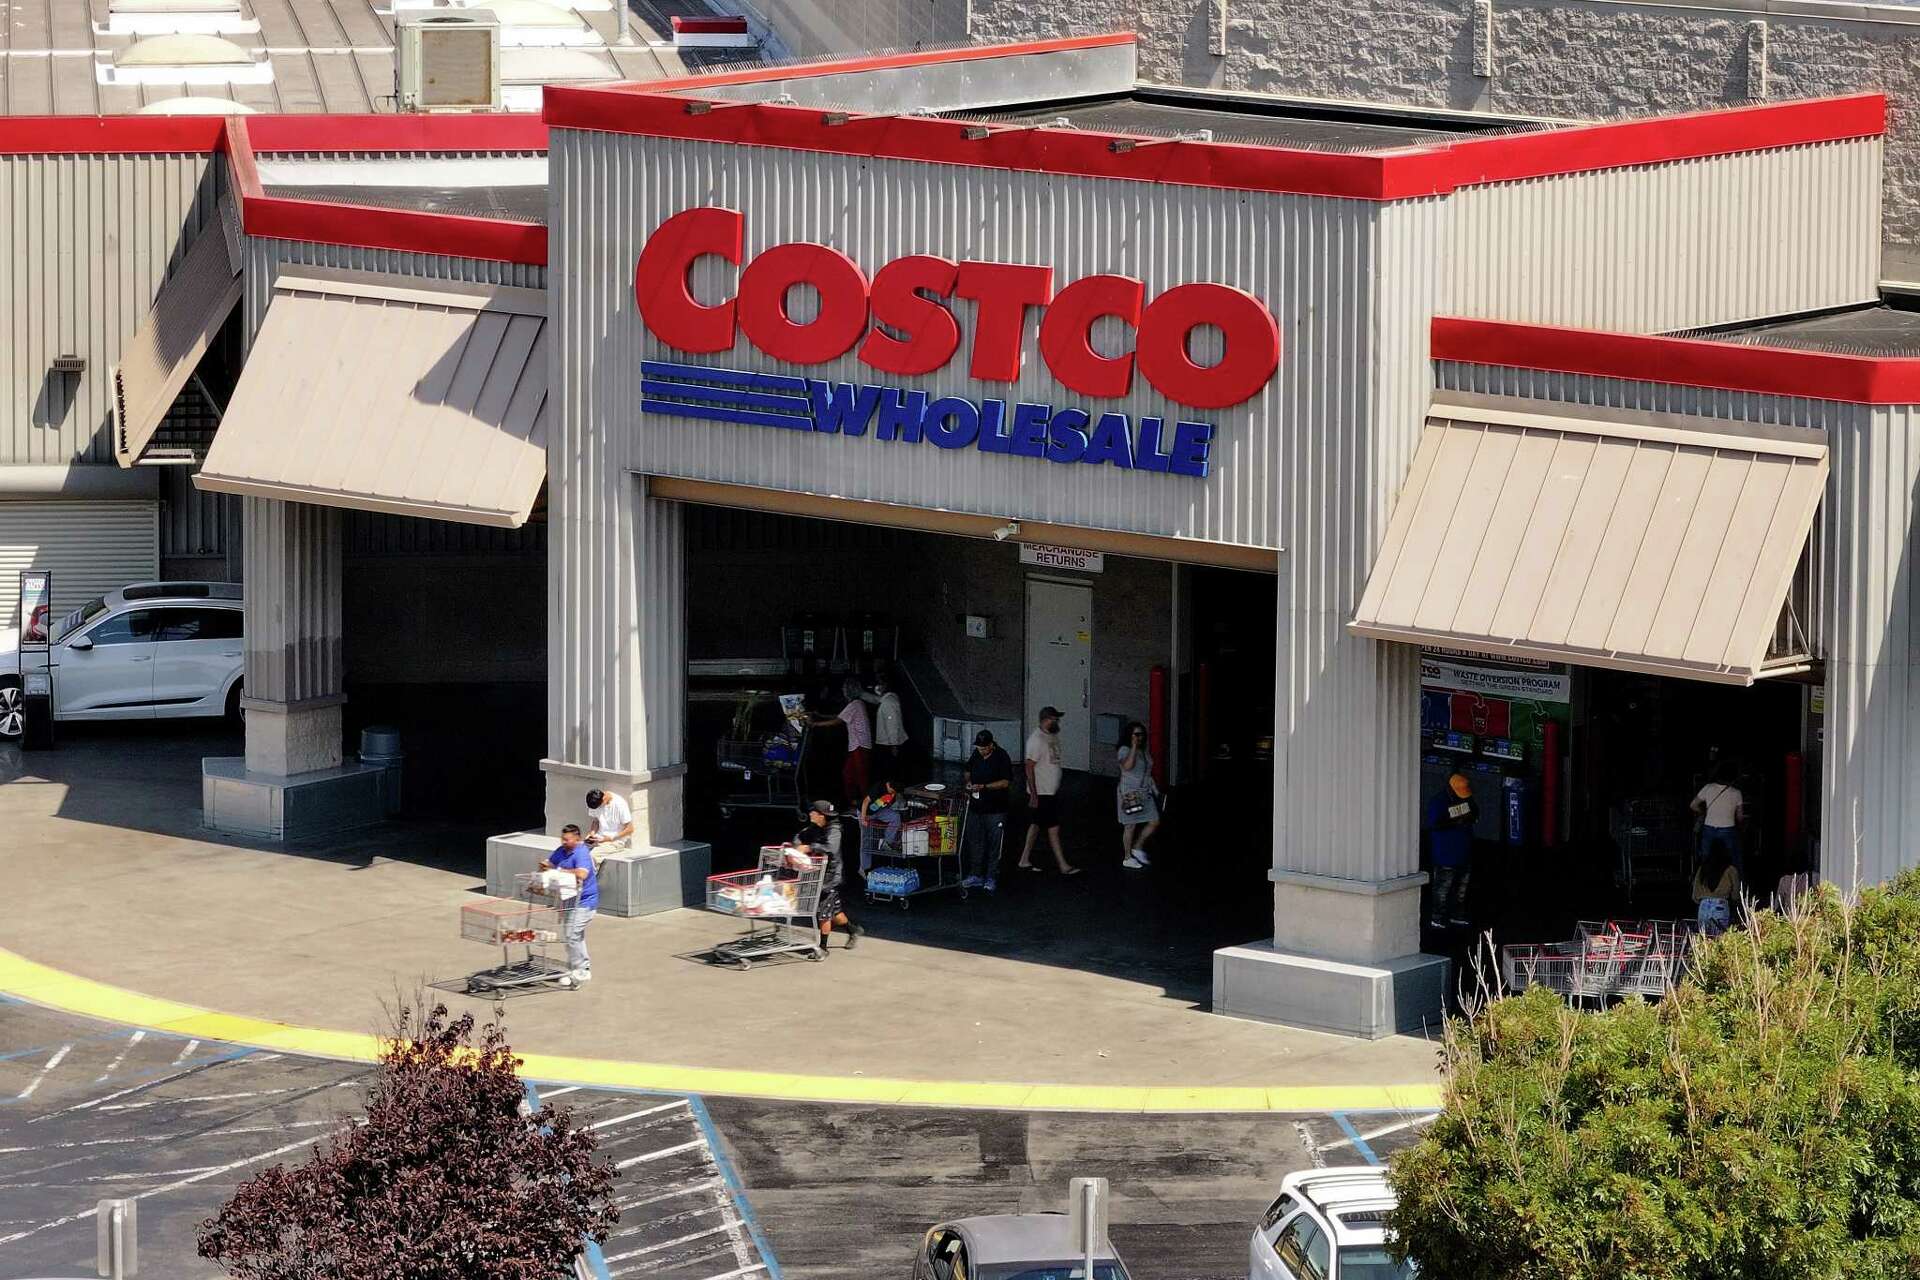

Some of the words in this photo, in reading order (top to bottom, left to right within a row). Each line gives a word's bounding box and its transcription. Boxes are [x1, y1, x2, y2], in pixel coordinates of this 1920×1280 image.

[636, 206, 1280, 410] COSTCO
[809, 379, 1215, 478] WHOLESALE
[1036, 552, 1086, 568] RETURNS
[1453, 669, 1480, 680] WASTE
[1480, 674, 1520, 686] DIVERSION
[1521, 679, 1560, 690] PROGRAM
